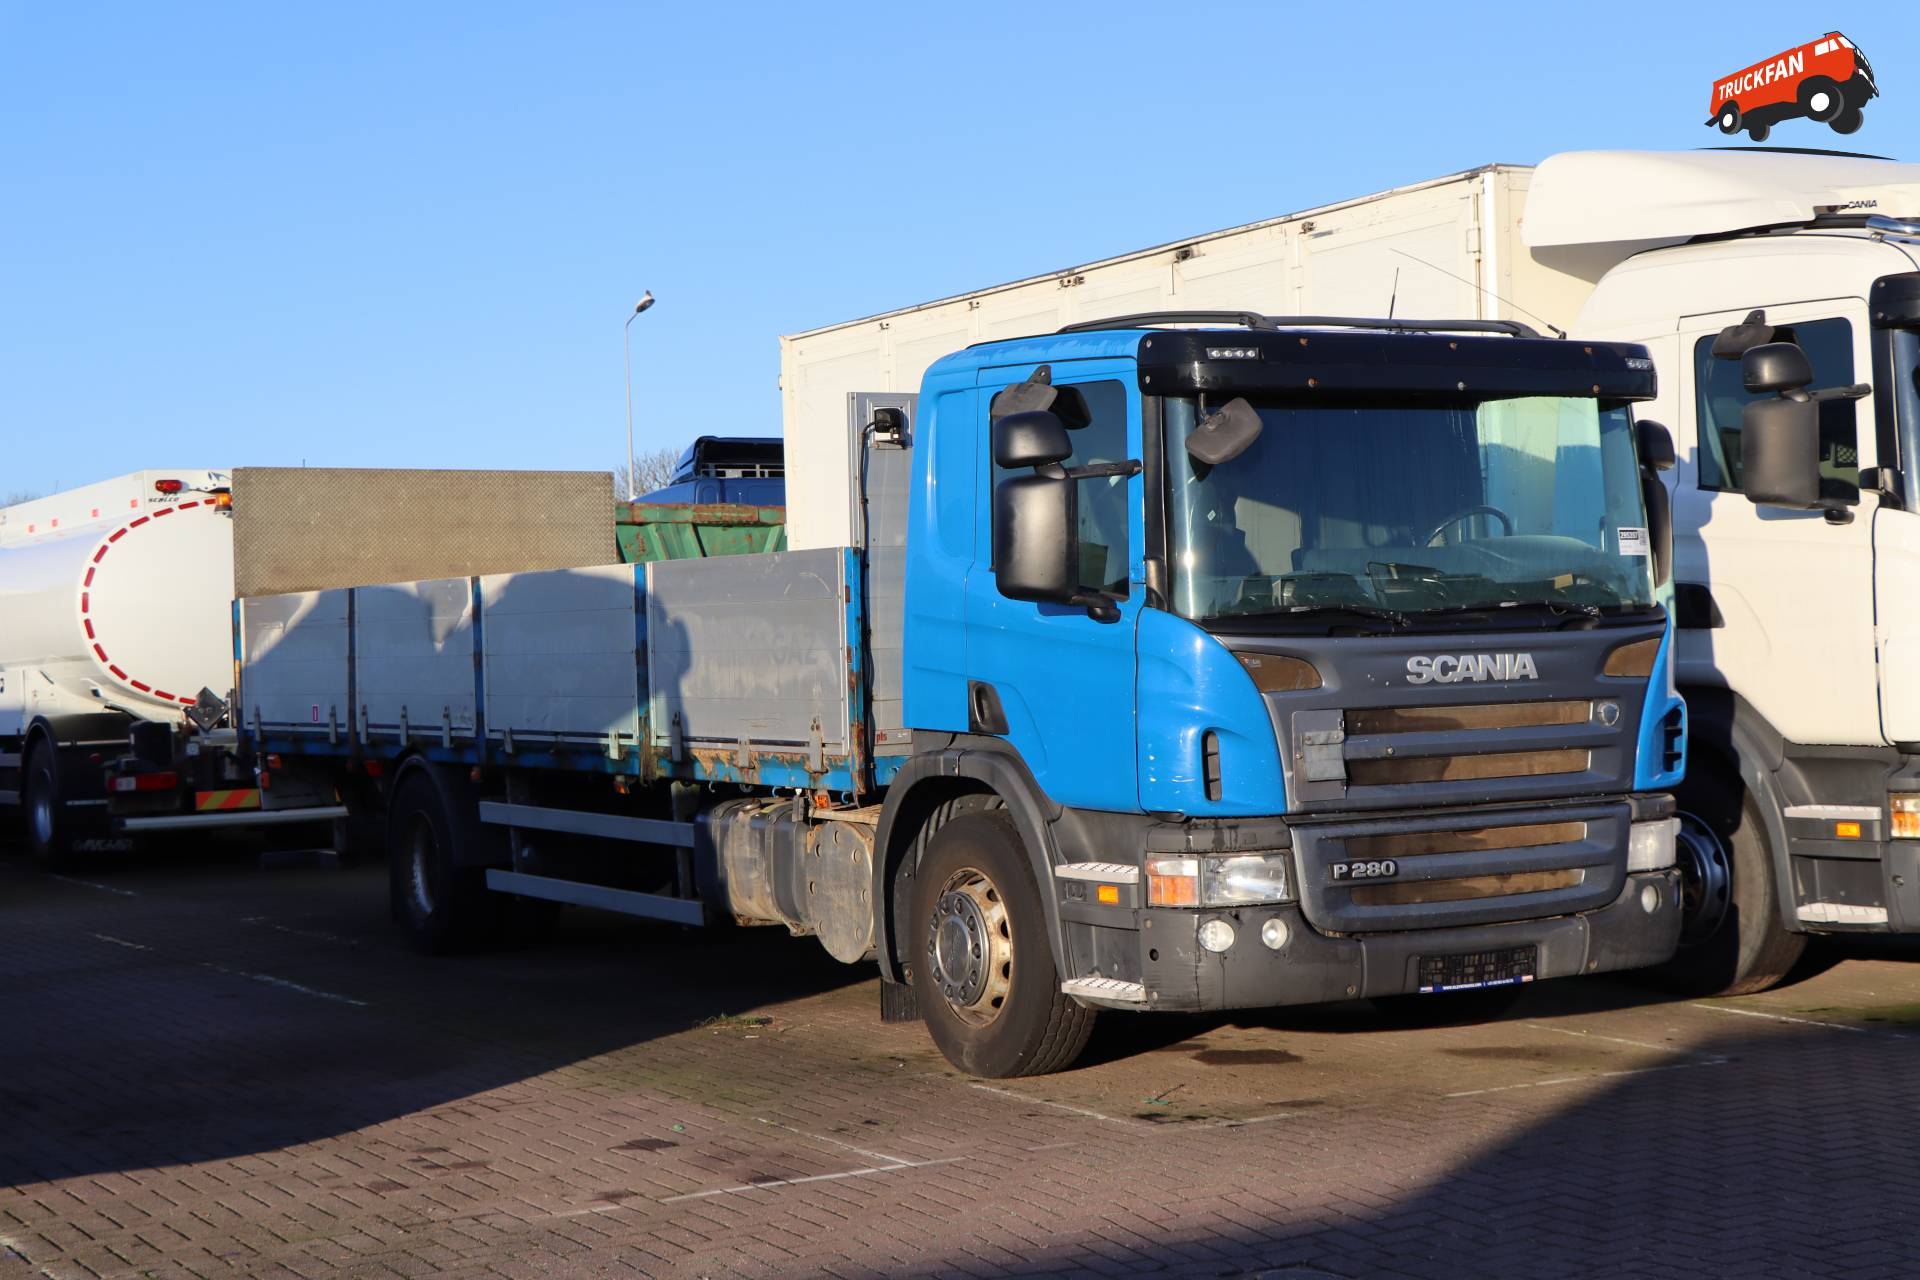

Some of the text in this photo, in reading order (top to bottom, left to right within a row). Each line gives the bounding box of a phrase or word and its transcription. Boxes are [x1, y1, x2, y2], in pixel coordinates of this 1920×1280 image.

[1840, 200, 1877, 209] CANIA
[1406, 653, 1539, 684] SCANIA
[1333, 861, 1396, 879] P 280
